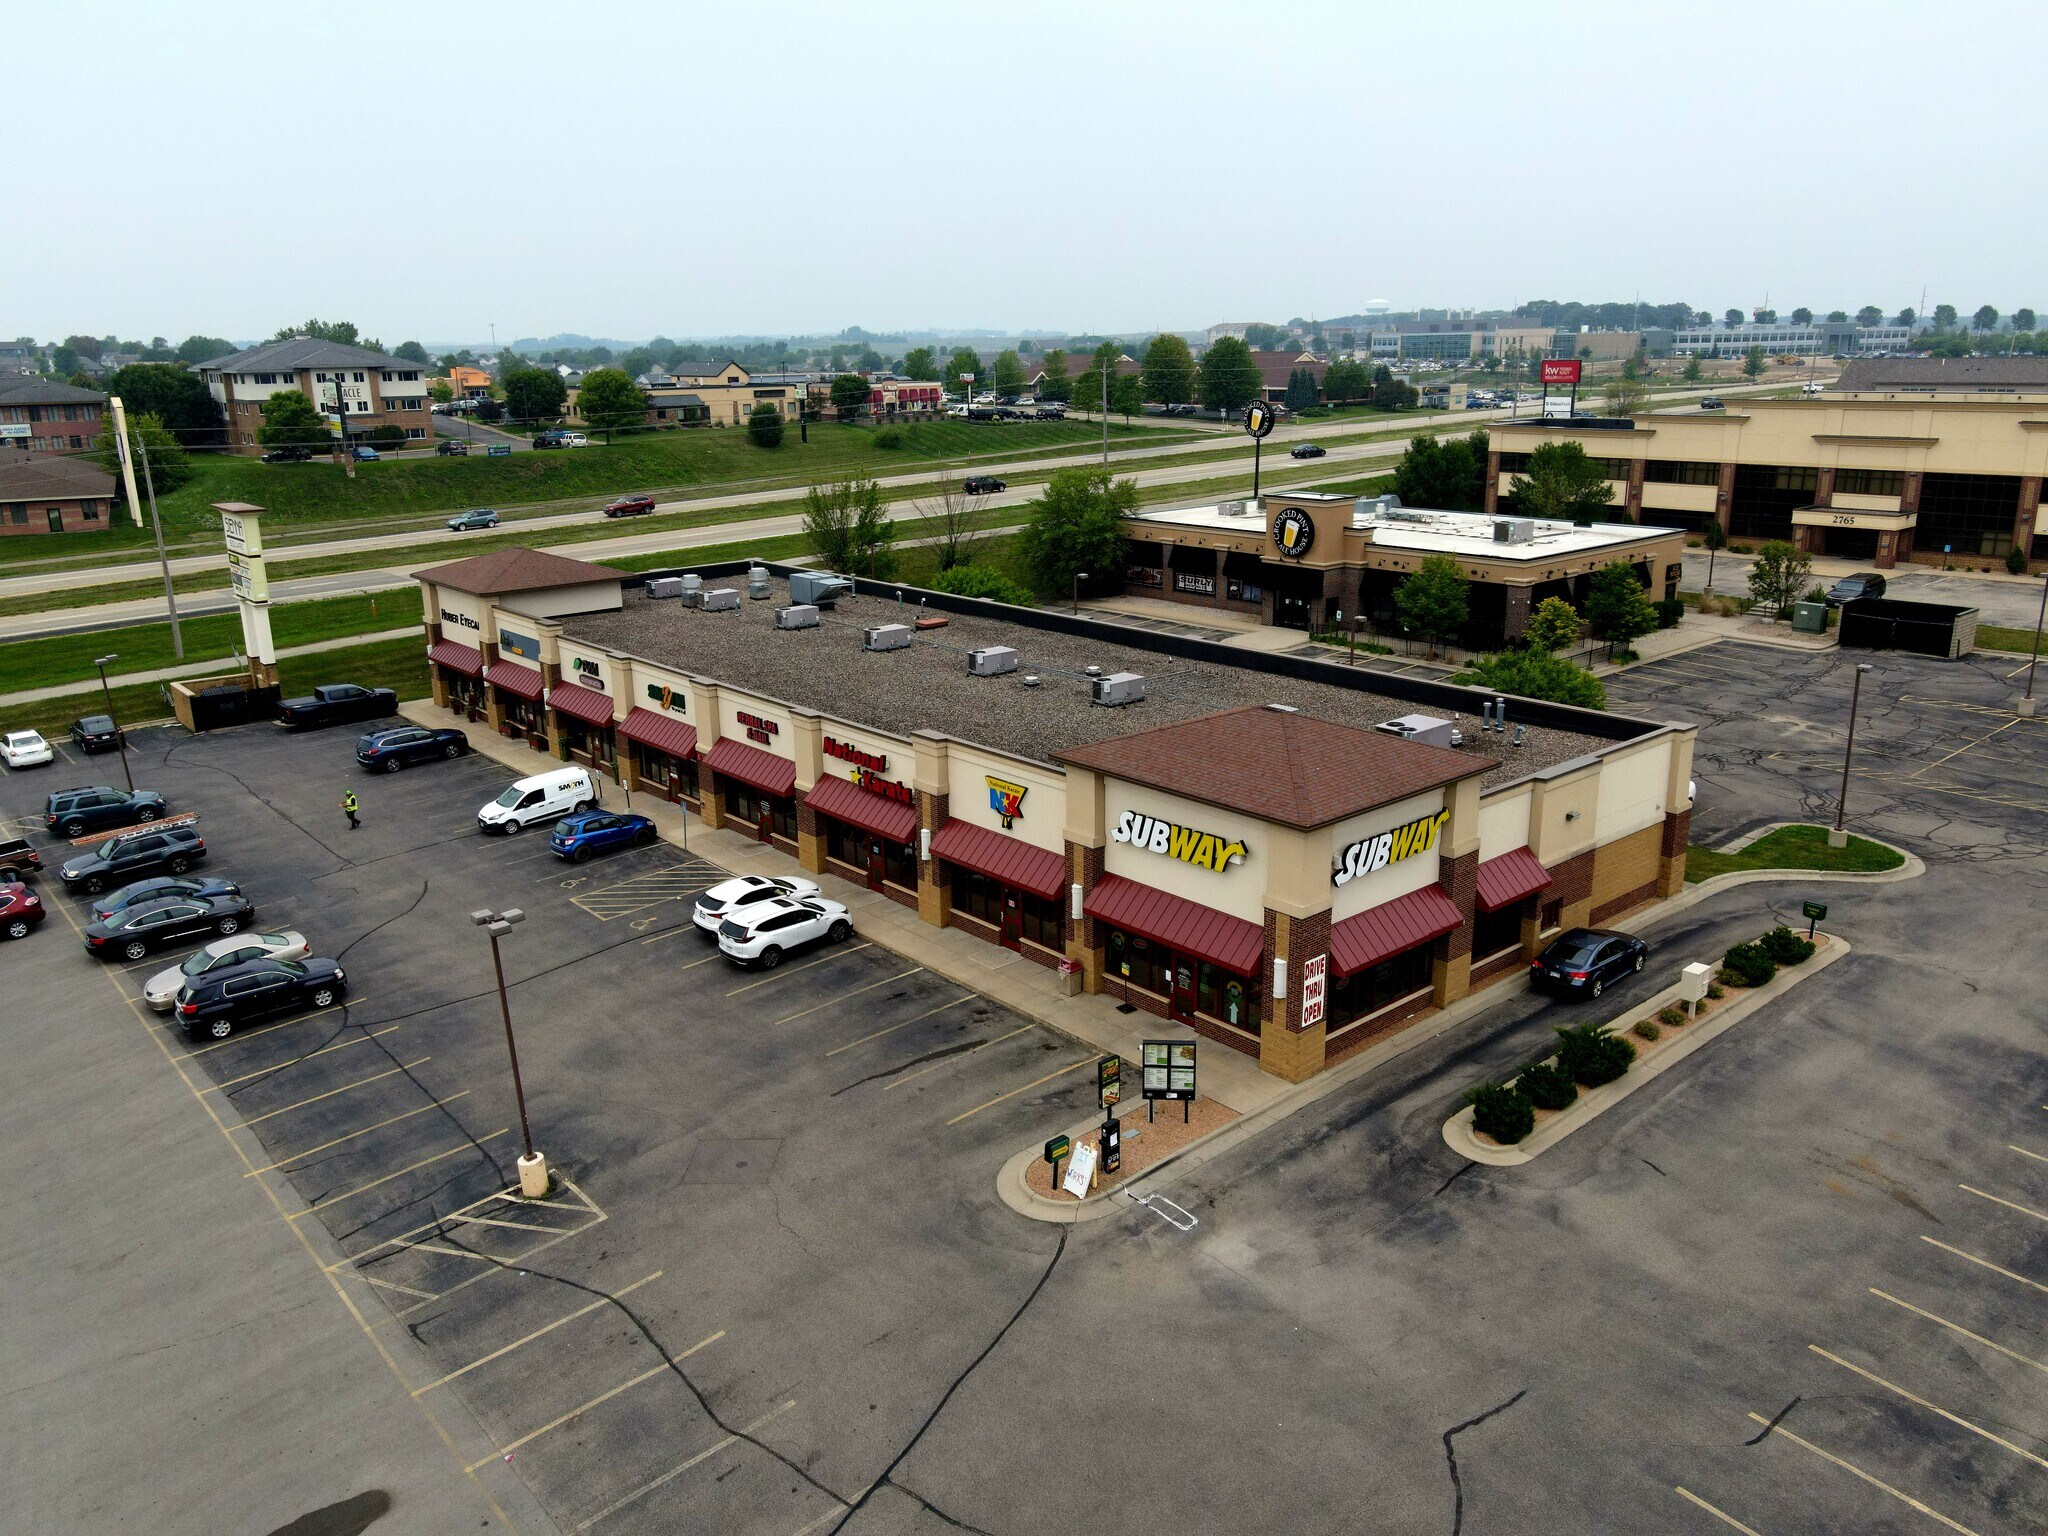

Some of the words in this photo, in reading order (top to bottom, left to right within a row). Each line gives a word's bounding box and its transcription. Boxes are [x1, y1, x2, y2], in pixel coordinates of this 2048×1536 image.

[1545, 364, 1560, 375] kw
[1273, 509, 1298, 540] CROOKED
[1296, 513, 1310, 533] PINT
[1833, 515, 1855, 525] 2765
[1278, 543, 1290, 555] ALE
[1290, 536, 1309, 555] HOUSE
[1179, 574, 1214, 588] SURLY
[441, 608, 460, 624] HUBER
[460, 613, 480, 631] EYECA
[737, 711, 764, 731] HERBAL
[763, 720, 779, 735] SPA
[823, 736, 887, 773] National
[862, 770, 912, 804] Karate
[1110, 810, 1249, 873] SUBWAY
[1331, 807, 1451, 888] SUBWAY
[1304, 957, 1325, 981] DRIVE
[1305, 979, 1323, 1002] THRU
[1303, 1002, 1322, 1024] OPEN
